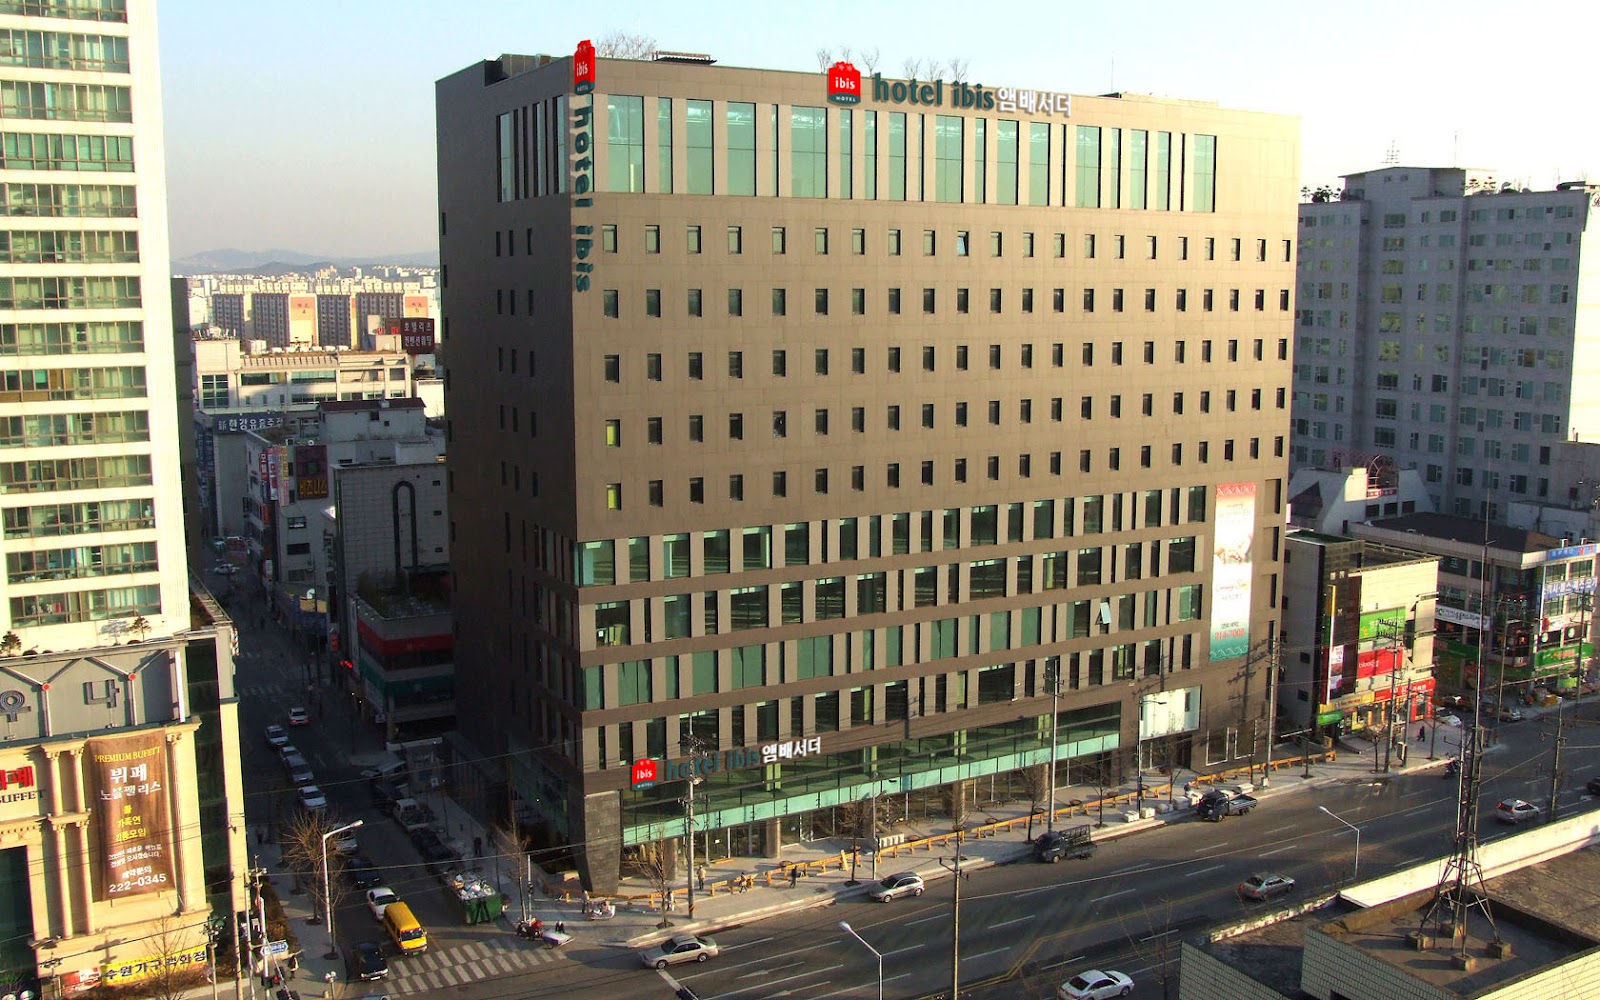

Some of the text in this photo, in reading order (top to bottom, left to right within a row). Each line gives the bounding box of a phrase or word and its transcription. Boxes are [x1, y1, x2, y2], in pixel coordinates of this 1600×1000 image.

[576, 62, 589, 77] ibis
[834, 76, 856, 90] ibis
[874, 71, 1072, 117] hotel ibis 앰배서더
[574, 105, 594, 292] hotel ibis
[95, 753, 132, 763] PREMIUM
[666, 736, 822, 781] hotel ibis 앰배서더
[110, 763, 148, 784] 뷔페
[636, 770, 653, 781] ibis
[109, 872, 168, 894] 222-0345
[103, 949, 207, 980] 수원가구백화점
